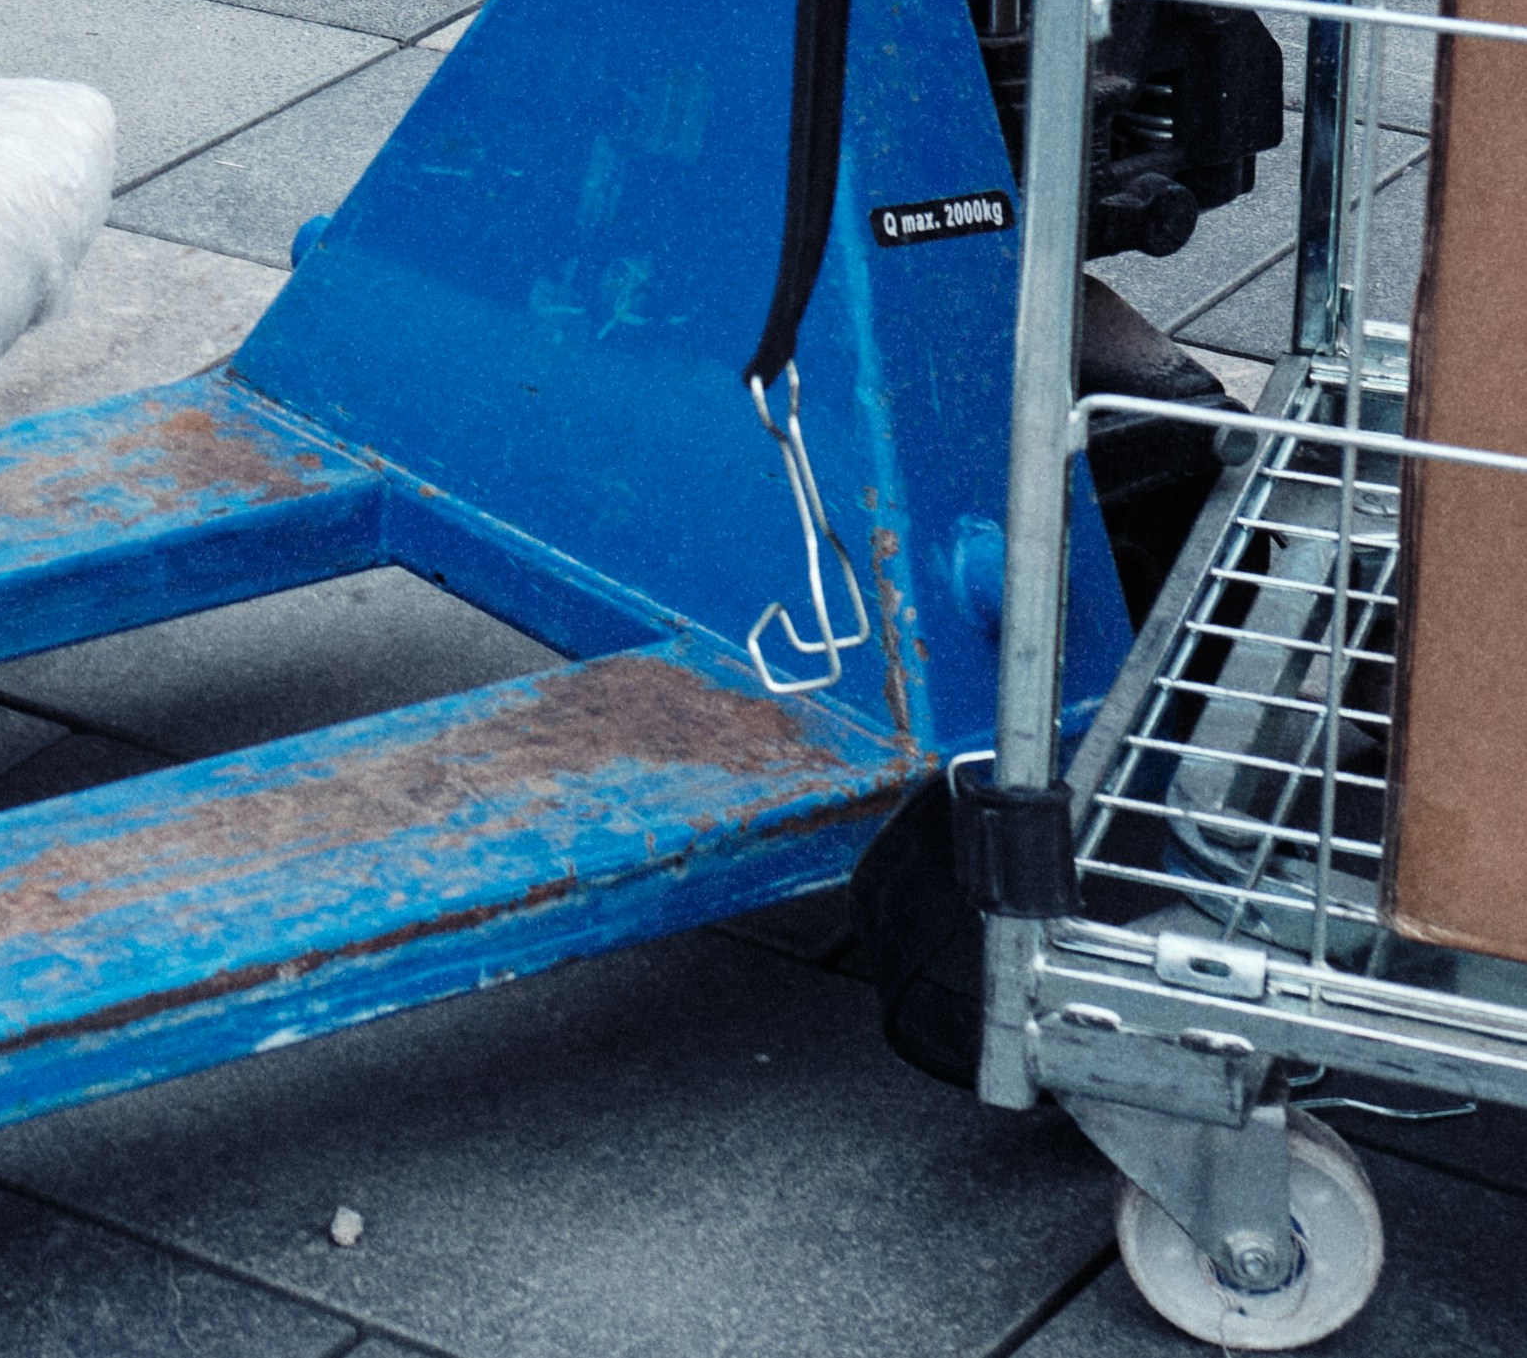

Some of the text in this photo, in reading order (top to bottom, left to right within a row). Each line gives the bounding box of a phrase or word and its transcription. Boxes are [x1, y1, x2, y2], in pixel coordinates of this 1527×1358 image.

[882, 197, 1005, 237] Q max. 2000kg
